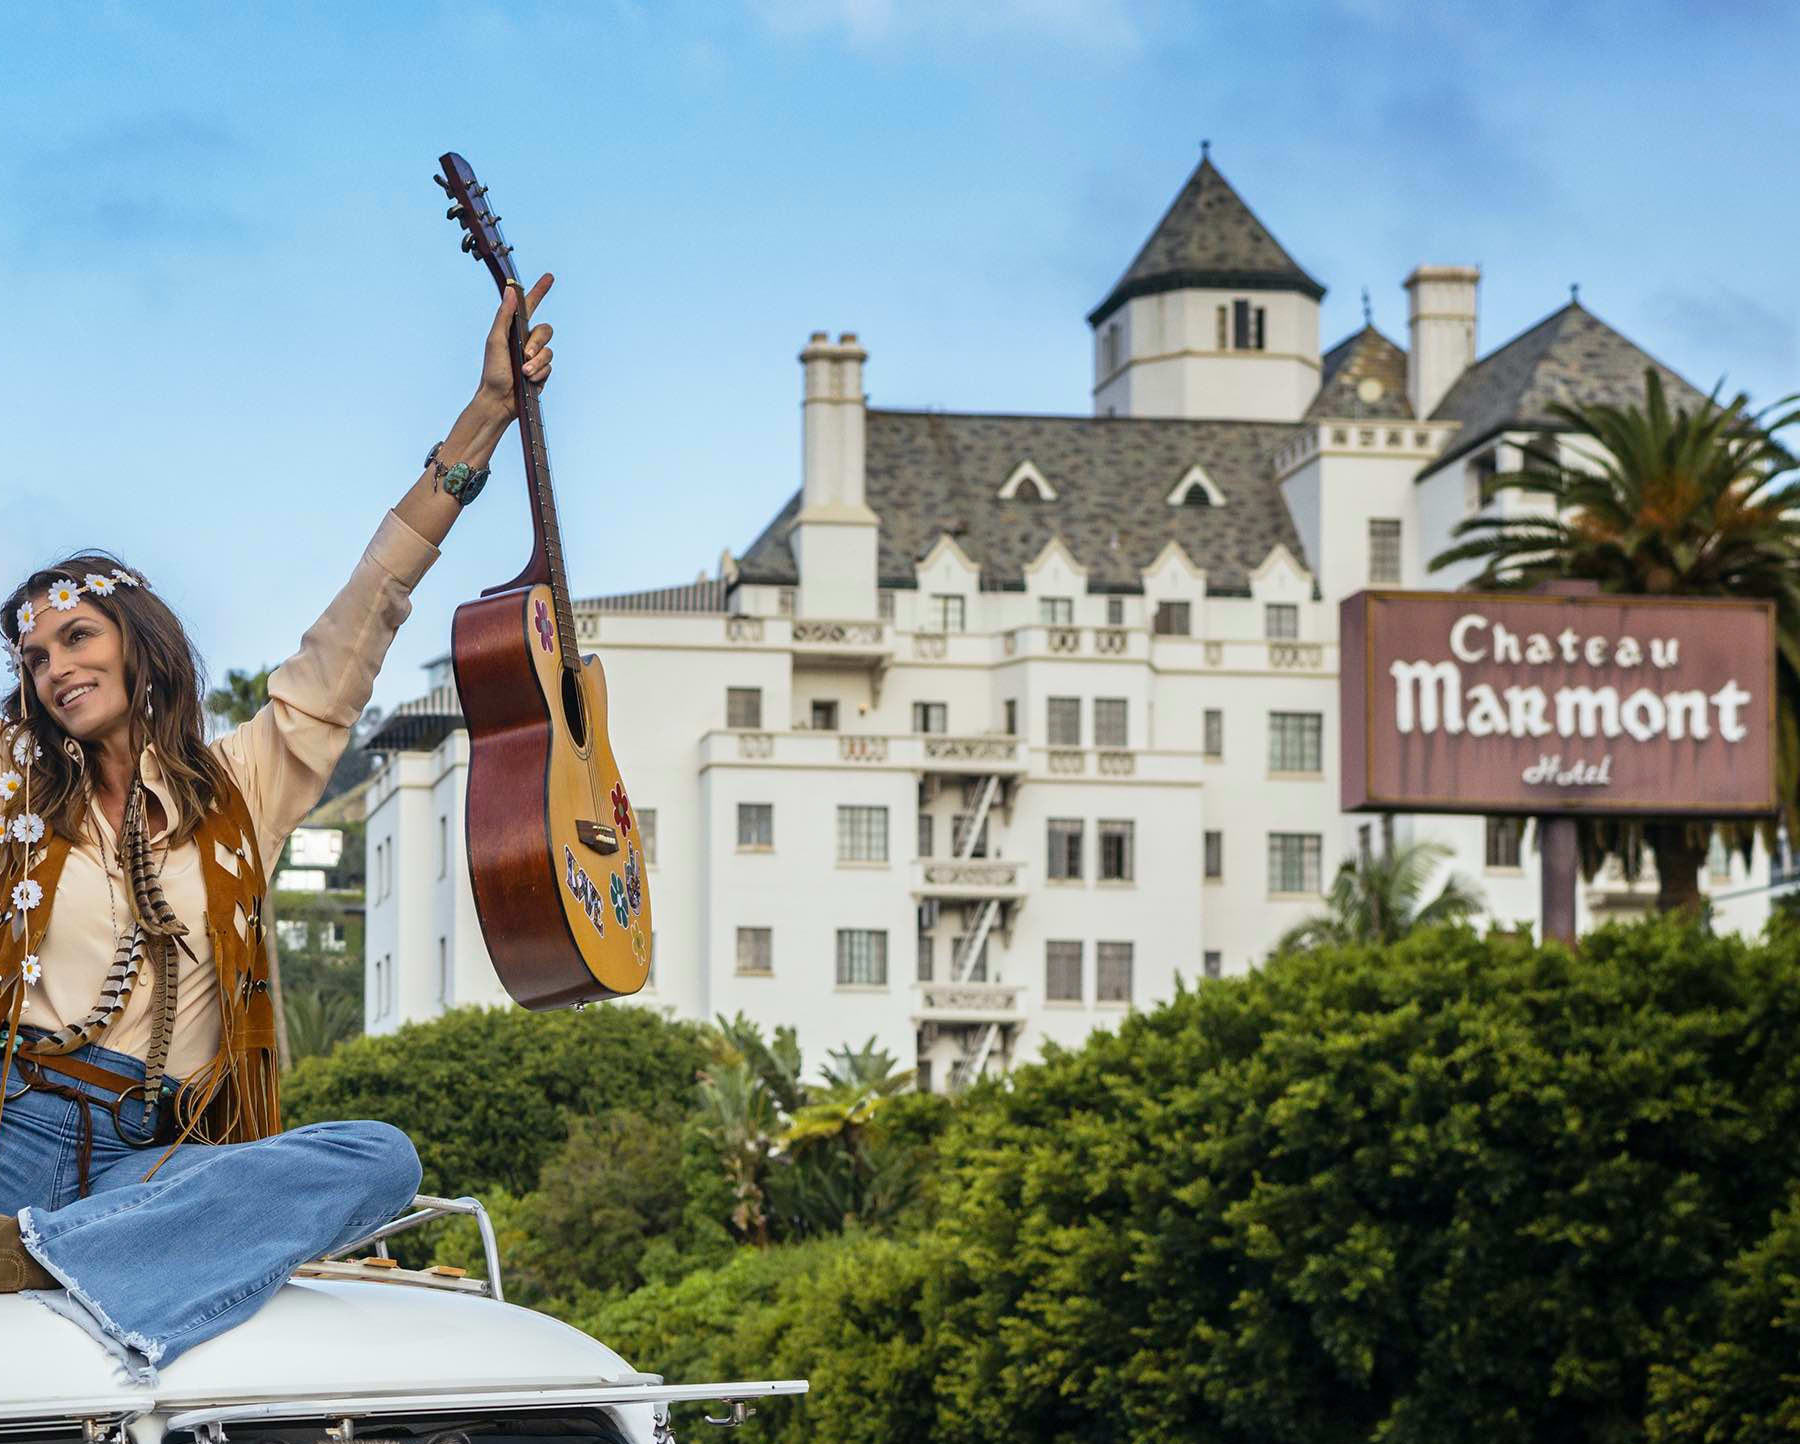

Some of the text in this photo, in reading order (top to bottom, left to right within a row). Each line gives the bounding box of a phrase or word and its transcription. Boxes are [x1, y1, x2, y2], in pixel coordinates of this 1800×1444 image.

[1450, 614, 1680, 669] Chateau
[1390, 658, 1753, 743] Marmont
[1522, 753, 1613, 787] Hotel
